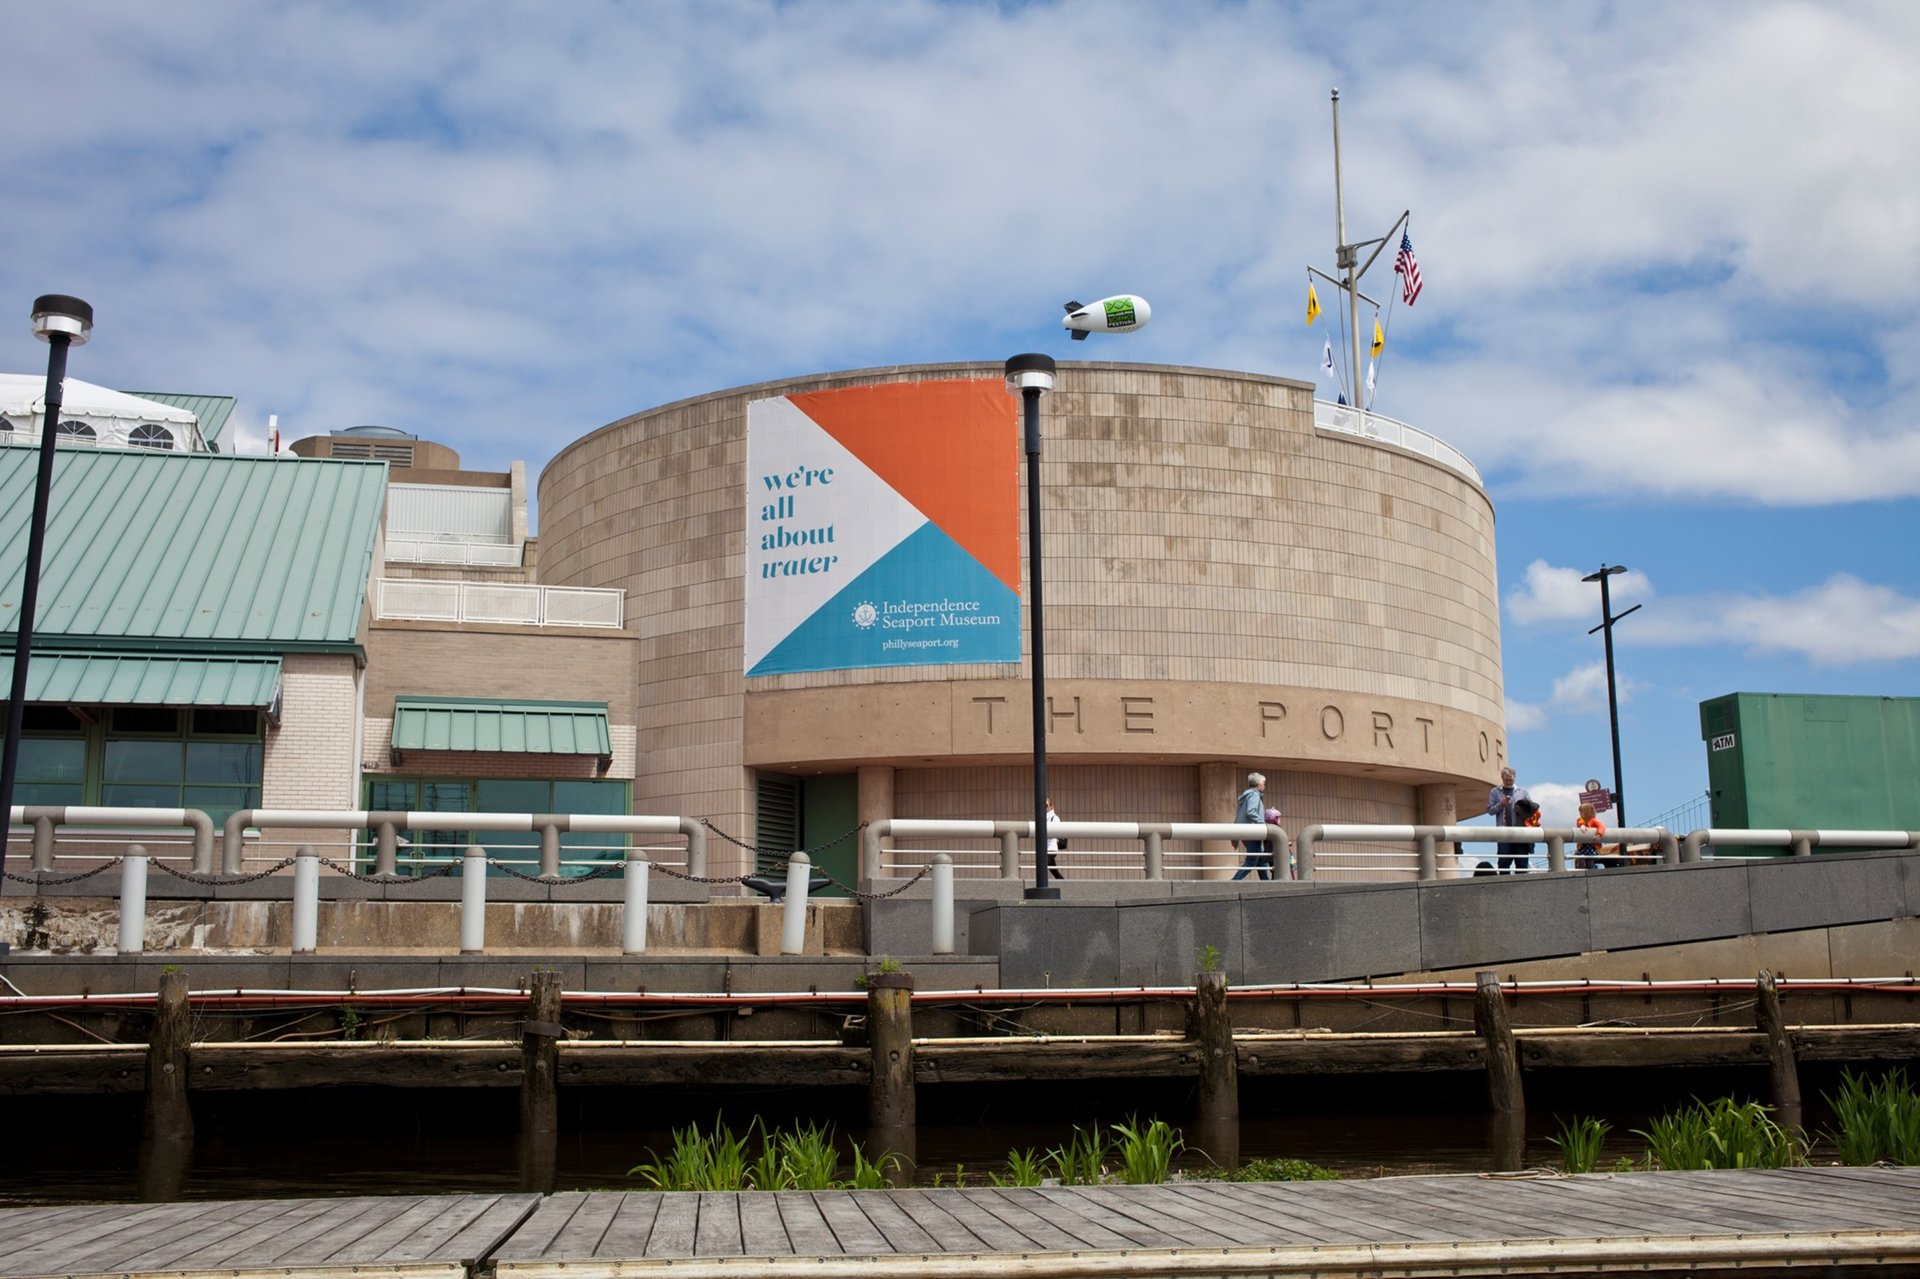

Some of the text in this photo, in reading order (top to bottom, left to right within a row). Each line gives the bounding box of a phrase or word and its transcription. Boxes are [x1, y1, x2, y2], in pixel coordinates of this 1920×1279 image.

[763, 465, 834, 491] we're
[761, 495, 794, 521] all
[761, 523, 835, 551] about
[762, 555, 838, 579] water
[883, 599, 980, 617] Independence
[882, 613, 1000, 631] Seaport Museum
[882, 638, 959, 651] phillyseaport.org
[971, 695, 1503, 772] THE PORT OF
[1714, 735, 1734, 750] ATM
